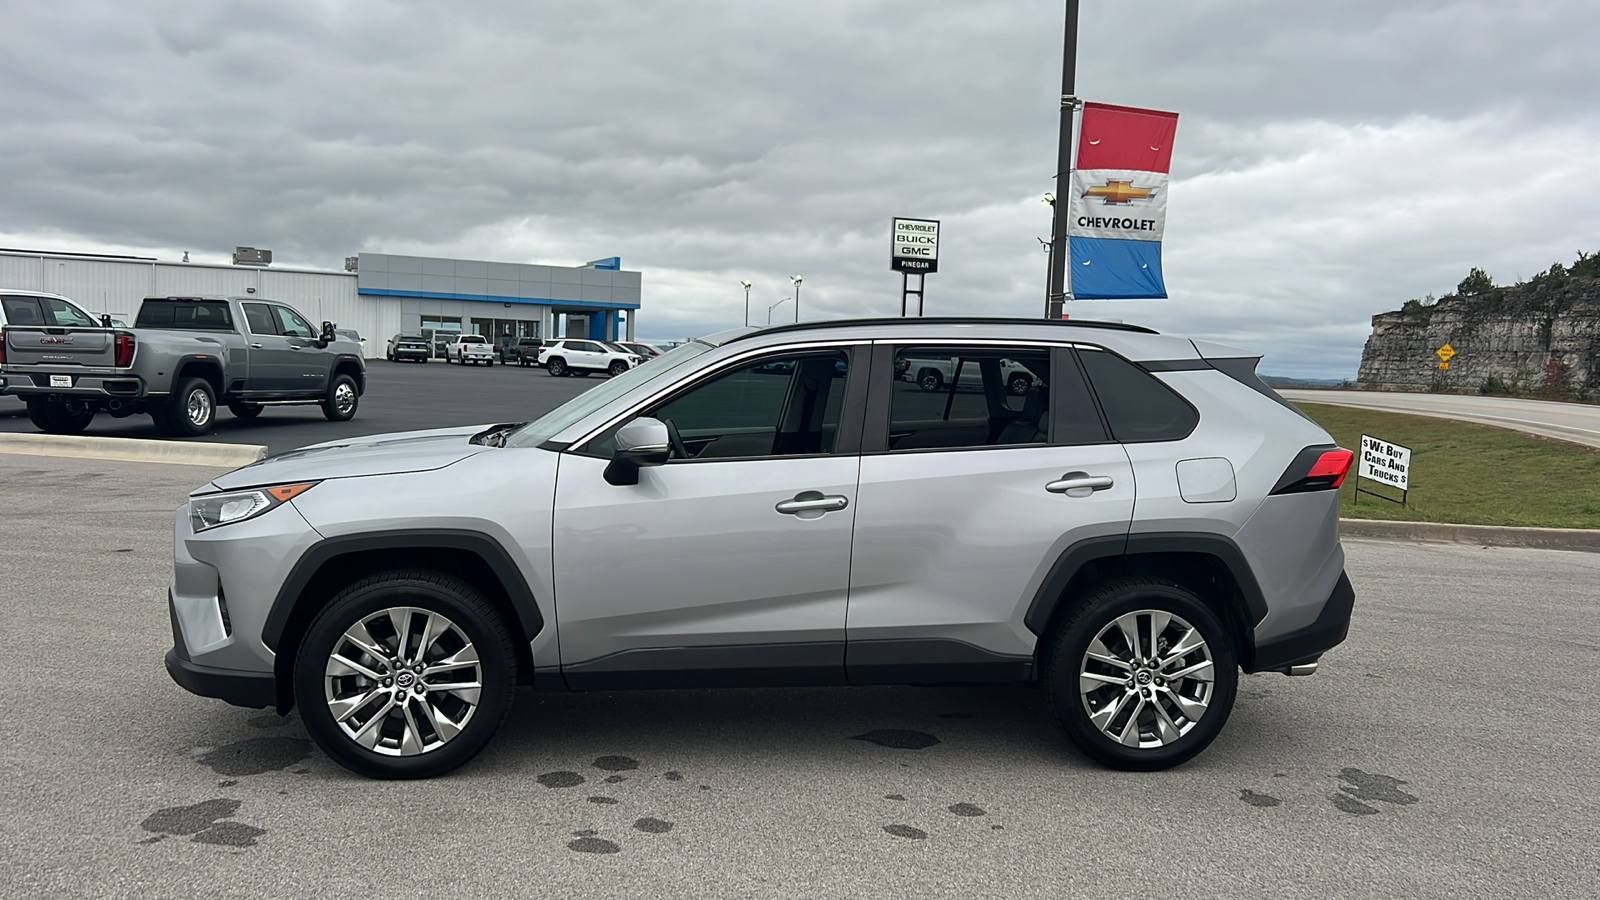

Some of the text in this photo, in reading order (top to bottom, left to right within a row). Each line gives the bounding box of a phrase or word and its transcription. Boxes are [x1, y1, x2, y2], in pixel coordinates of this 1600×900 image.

[898, 223, 936, 232] CHEVROLET
[1078, 216, 1156, 231] CHEVROLET
[897, 235, 935, 244] BUICK
[902, 246, 930, 256] GMC
[901, 260, 929, 268] PINEGAR
